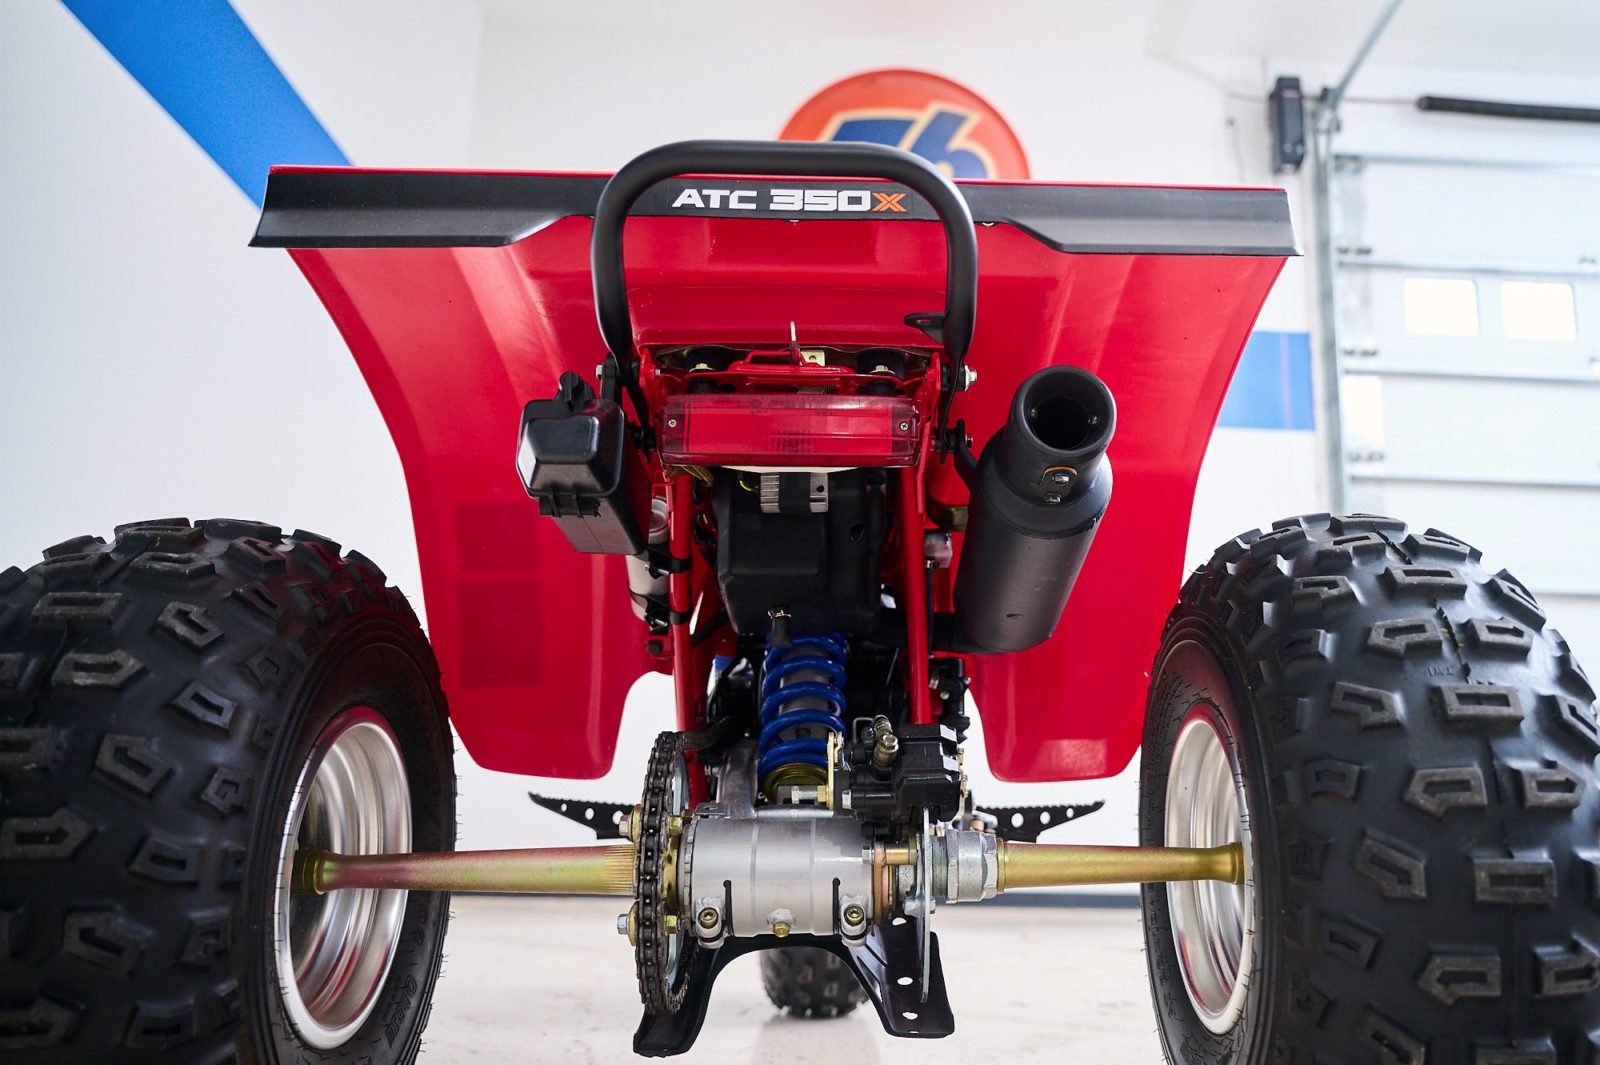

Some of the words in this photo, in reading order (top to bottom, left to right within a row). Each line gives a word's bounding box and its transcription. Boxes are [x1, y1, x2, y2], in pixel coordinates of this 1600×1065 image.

[820, 104, 997, 178] 6
[671, 188, 757, 209] ATC
[769, 189, 907, 212] 350X
